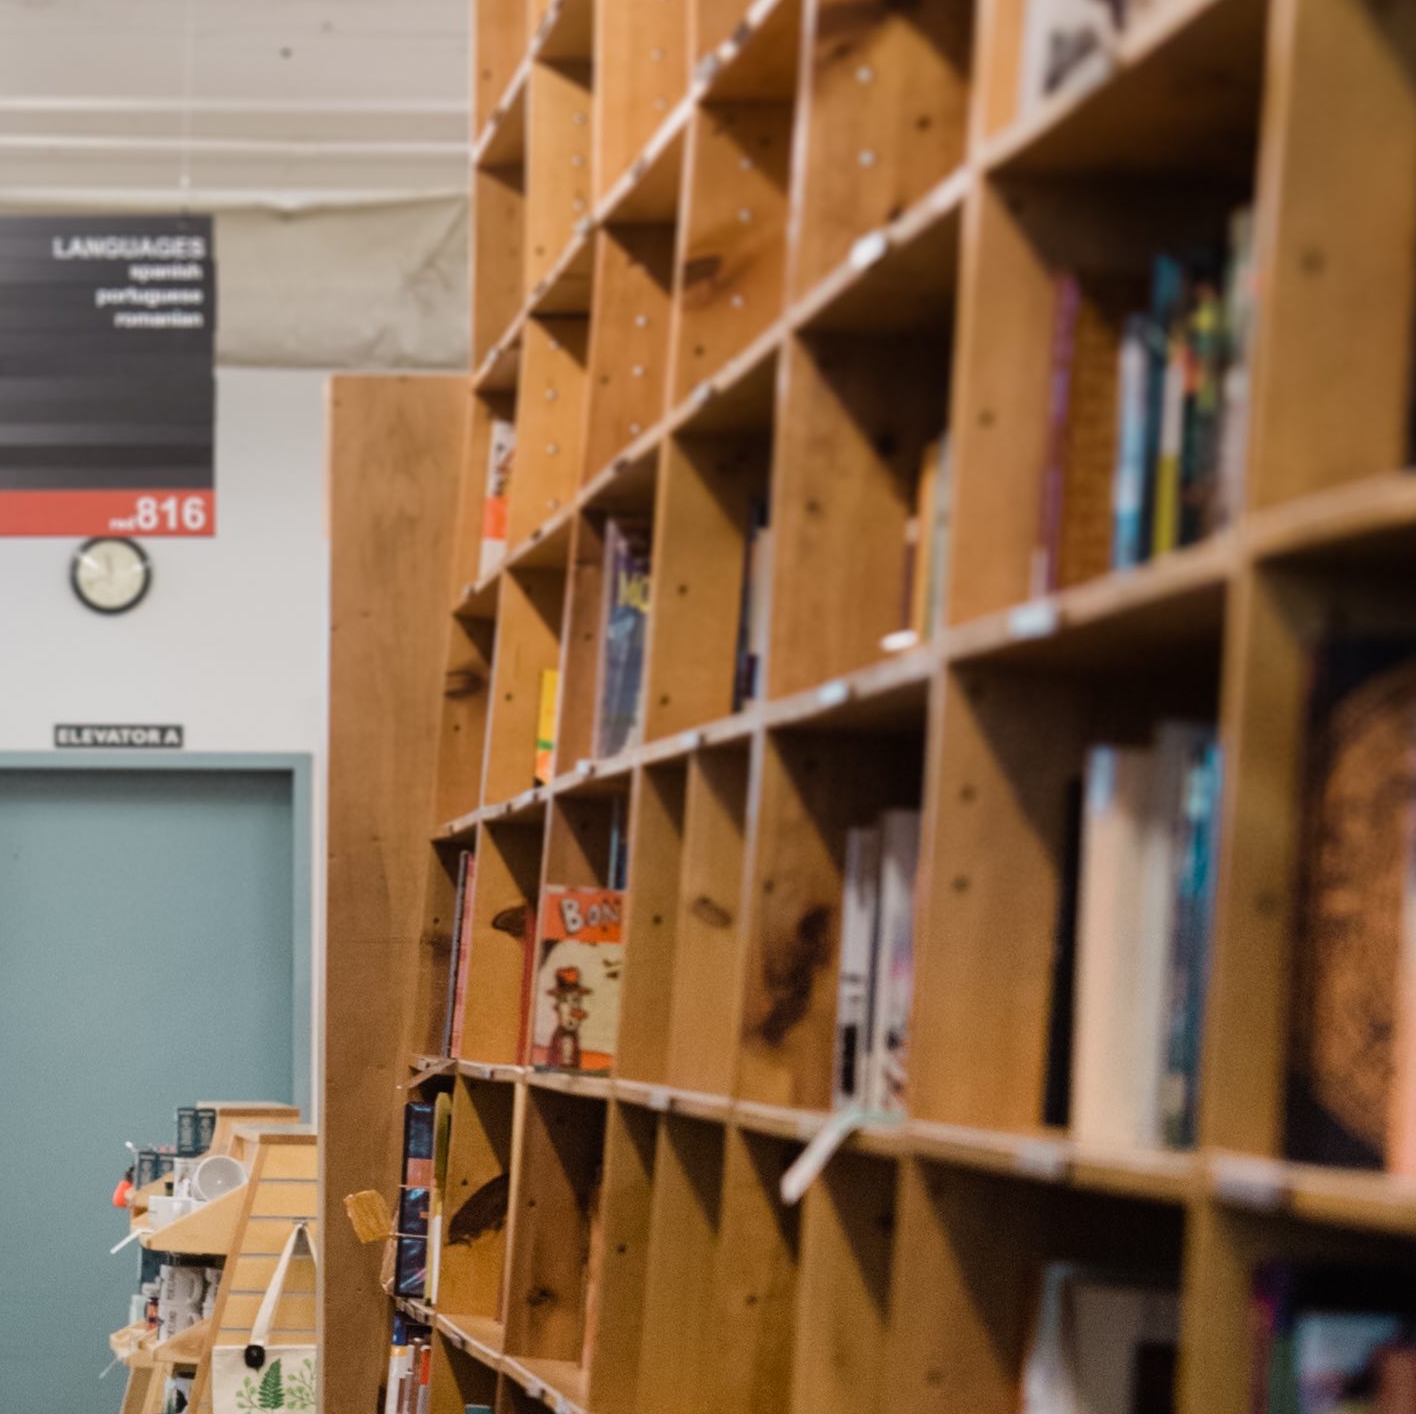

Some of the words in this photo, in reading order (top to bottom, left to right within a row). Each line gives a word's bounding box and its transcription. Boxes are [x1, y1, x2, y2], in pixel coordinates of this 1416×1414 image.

[52, 237, 206, 260] LANGUAGES
[128, 263, 204, 284] spanish
[95, 286, 204, 309] portuguese
[113, 310, 205, 329] romanian
[136, 496, 206, 531] 816
[57, 728, 161, 744] ELEVATOR
[164, 728, 180, 744] A
